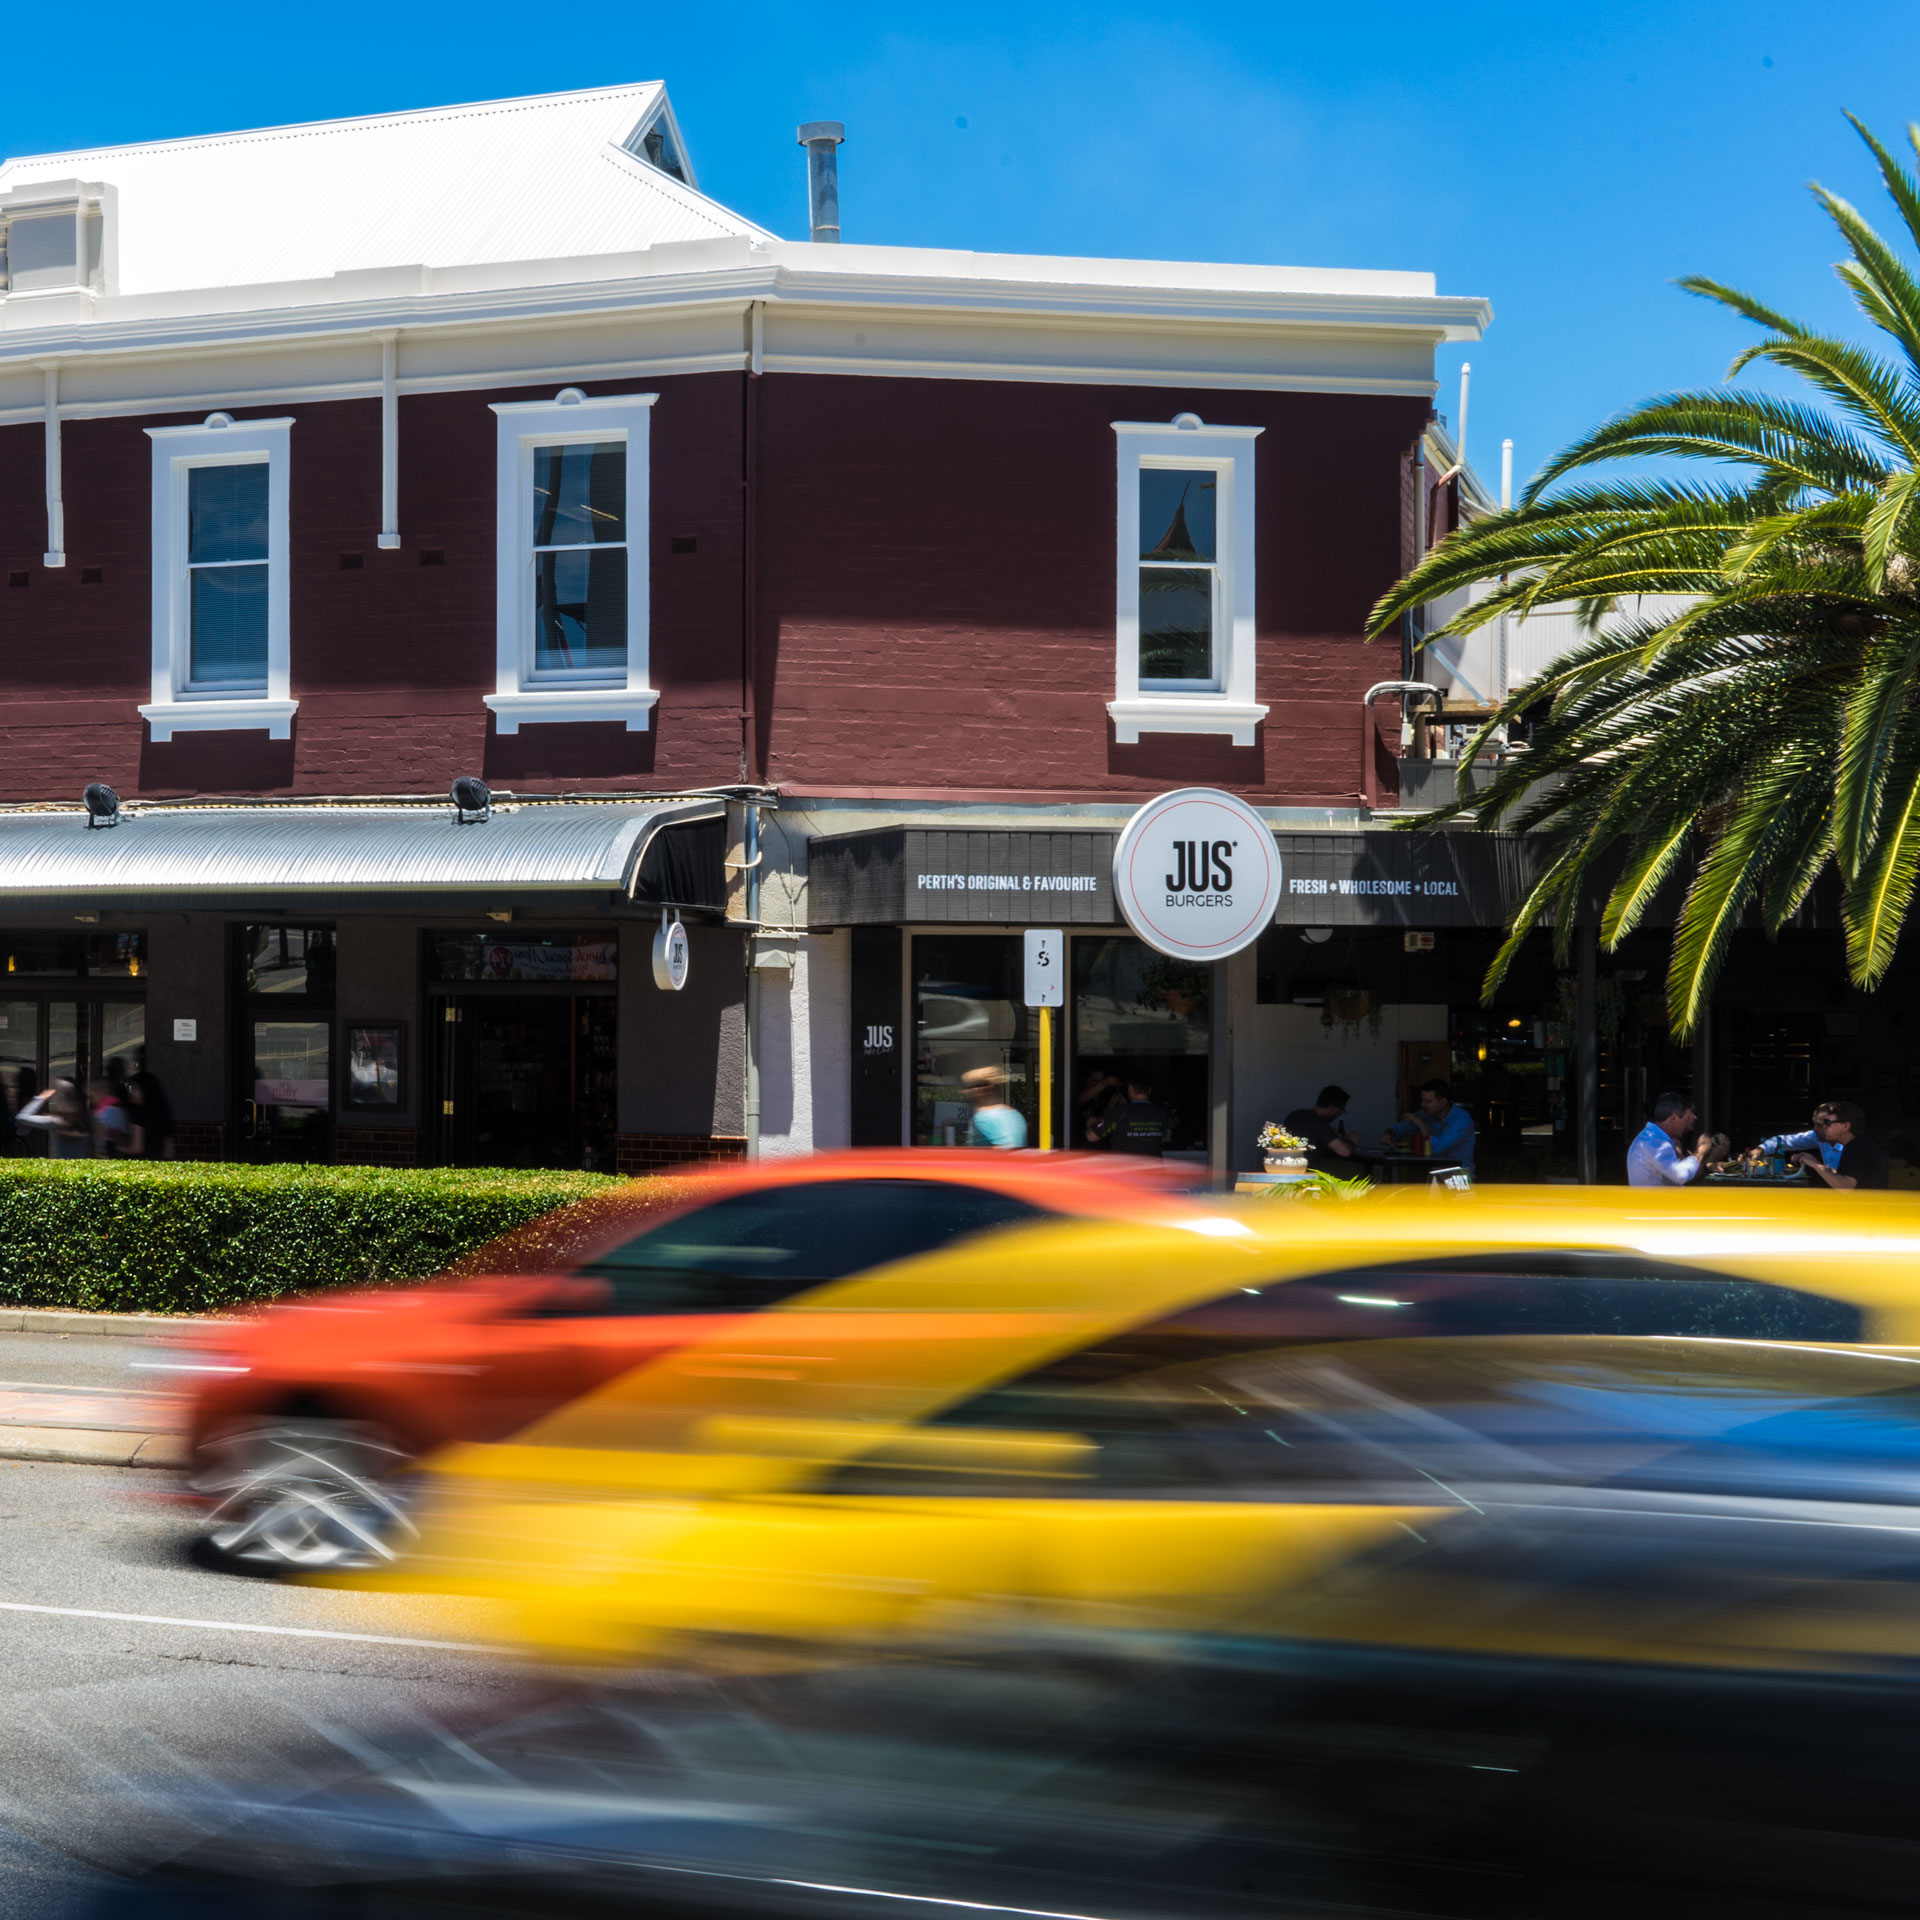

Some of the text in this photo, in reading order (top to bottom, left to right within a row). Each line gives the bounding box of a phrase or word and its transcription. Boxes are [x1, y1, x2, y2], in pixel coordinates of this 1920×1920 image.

[917, 874, 1097, 892] PERTH'S ORIGINAL & FAVOURITE
[1289, 879, 1459, 896] FRESH WHOLESOME LOCAL
[1165, 894, 1233, 907] BURGERS
[863, 1025, 893, 1048] JUS
